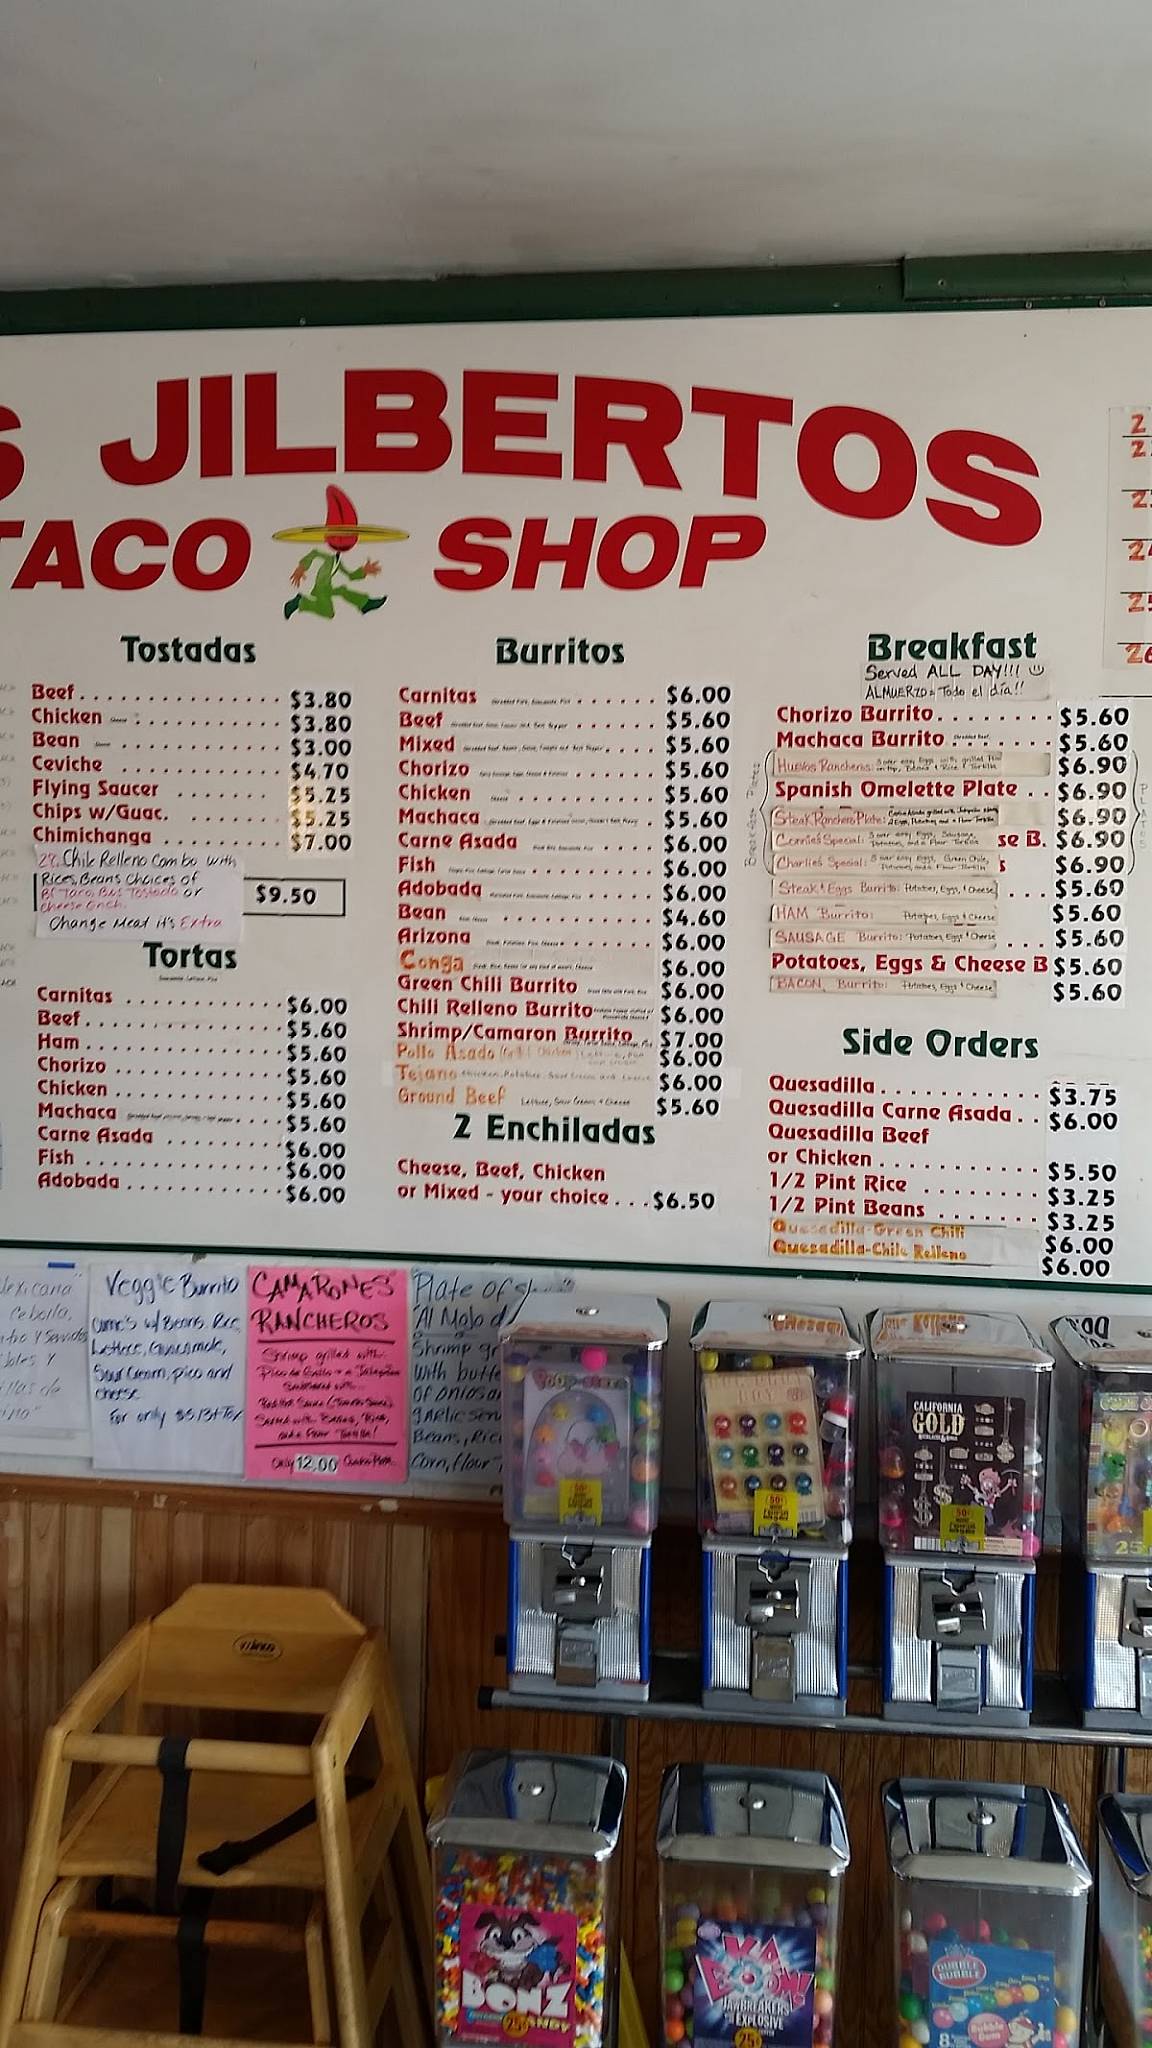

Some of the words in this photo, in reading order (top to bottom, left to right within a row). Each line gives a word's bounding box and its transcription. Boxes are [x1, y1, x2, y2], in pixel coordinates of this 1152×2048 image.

[100, 369, 1042, 547] JILBERTOS
[434, 515, 766, 591] SHOP
[120, 635, 256, 663] Tostadas
[496, 637, 624, 665] Burritos
[868, 631, 1037, 662] Breakfast
[864, 665, 917, 681] Served
[927, 664, 961, 677] ALL
[972, 663, 1020, 678] DAY!!!
[32, 684, 74, 700] Beef
[291, 690, 351, 710] $3.80
[399, 687, 476, 704] Carnitas
[938, 685, 965, 697] Todo
[972, 686, 983, 697] el
[32, 707, 102, 724] Chicken
[291, 714, 351, 735] $3.80
[400, 711, 442, 728] Beef
[777, 706, 852, 723] Chorizo
[861, 704, 933, 722] Burrito
[33, 731, 79, 748] Bean
[291, 737, 351, 758] $3.00
[400, 735, 455, 752] Mixed
[666, 734, 729, 756] $5.60
[777, 731, 863, 748] Machaca
[872, 730, 944, 747] Burrito
[1059, 733, 1128, 755] $5.60
[33, 755, 102, 772] Ceviche
[291, 761, 349, 781] $4.70
[399, 759, 469, 777] Chorizo
[33, 779, 90, 799] Flying
[98, 780, 158, 797] Saucer
[399, 784, 470, 801] Chicken
[665, 784, 728, 805] $5.60
[776, 781, 852, 802] Spanish
[861, 780, 955, 798] Omelette
[963, 780, 1017, 797] Plate
[33, 803, 81, 823] Chips
[89, 804, 168, 821] w/Guac.
[291, 809, 351, 829] $5.25
[399, 808, 480, 825] Machaca
[1057, 807, 1126, 826] $6.90
[33, 826, 151, 846] Chimichanga
[291, 832, 351, 852] $7.00
[399, 832, 452, 849] Carne
[460, 833, 517, 851] Asada
[664, 834, 727, 854] $6.00
[206, 855, 236, 868] with
[399, 856, 435, 874] Fish
[1055, 856, 1124, 876] $6.90
[181, 870, 201, 885] of
[183, 888, 203, 898] or
[256, 884, 316, 905] $9.50
[398, 880, 481, 897] Adobada
[663, 883, 726, 903] $6.00
[399, 903, 445, 920] Bean
[663, 907, 725, 928] $4.60
[776, 905, 808, 920] HAM
[1053, 905, 1121, 924] $5.60
[398, 927, 470, 945] Arizona
[775, 931, 846, 944] SAUSAGE
[143, 941, 237, 969] Tortas
[400, 949, 463, 974] Conga
[772, 953, 865, 972] Potatoes,
[876, 954, 922, 975] Eggs
[931, 955, 946, 971] &
[955, 955, 1025, 972] Cheese
[1034, 956, 1048, 972] B
[38, 986, 112, 1003] Carnitas
[398, 974, 452, 991] Green
[461, 975, 501, 992] Chili
[510, 976, 577, 994] Burrito
[661, 981, 724, 1001] $6.00
[1053, 982, 1122, 1002] $5.60
[398, 998, 438, 1015] Chili
[447, 999, 517, 1017] Relleno
[526, 1001, 592, 1018] Burrito
[38, 1009, 80, 1026] Beef
[288, 1019, 347, 1040] $5.60
[398, 1021, 556, 1042] Shrimp/Camaron
[563, 1026, 632, 1042] Burrito
[660, 1029, 723, 1049] $7.00
[38, 1033, 79, 1050] Ham
[843, 1028, 912, 1056] Side
[926, 1029, 1038, 1058] Orders
[38, 1056, 106, 1073] Chorizo
[660, 1050, 722, 1068] $6.00
[38, 1079, 107, 1096] Chicken
[287, 1090, 346, 1110] $5.60
[399, 1088, 454, 1103] Ground
[466, 1086, 503, 1104] Beef
[657, 1096, 719, 1117] $5.60
[770, 1075, 874, 1094] Quesadilla
[1050, 1087, 1116, 1107] $3.75
[38, 1102, 116, 1119] Machaca
[769, 1099, 874, 1118] Quesadilla
[883, 1103, 940, 1120] Carne
[949, 1104, 1011, 1122] Asada
[453, 1113, 471, 1139] 2
[487, 1113, 655, 1145] Enchiladas
[769, 1123, 873, 1142] Quesadilla
[883, 1127, 929, 1144] Beef
[38, 1126, 90, 1142] Carne
[97, 1127, 153, 1144] Asada
[285, 1140, 345, 1158] $6.00
[39, 1148, 73, 1166] Fish
[768, 1152, 788, 1164] or
[796, 1148, 871, 1167] Chicken
[1048, 1162, 1116, 1182] $5.50
[398, 1159, 466, 1178] Cheese,
[476, 1161, 524, 1180] Beef,
[533, 1163, 604, 1181] Chicken
[38, 1172, 119, 1189] Adobada
[286, 1184, 345, 1204] $6.00
[398, 1186, 416, 1198] or
[424, 1183, 478, 1200] Mixed
[501, 1189, 543, 1205] your
[551, 1187, 608, 1205] choice
[654, 1191, 714, 1211] $6.50
[770, 1171, 805, 1189] 1/2
[816, 1173, 855, 1190] Pint
[865, 1175, 906, 1193] Rice
[1048, 1187, 1114, 1207] $3.25
[770, 1195, 804, 1214] 1/2
[815, 1197, 855, 1214] Pint
[864, 1199, 924, 1217] Beans
[1048, 1211, 1114, 1232] $3.25
[1045, 1234, 1113, 1255] $6.00
[107, 1270, 173, 1305] Veggie
[179, 1274, 239, 1298] Burrito
[413, 1271, 473, 1304] Plate
[482, 1276, 512, 1302] of
[251, 1305, 390, 1334] RANCHEROS
[914, 1401, 962, 1413] CALIFORNIA
[912, 1412, 965, 1436] GOLD
[462, 1972, 572, 2018] BONZ
